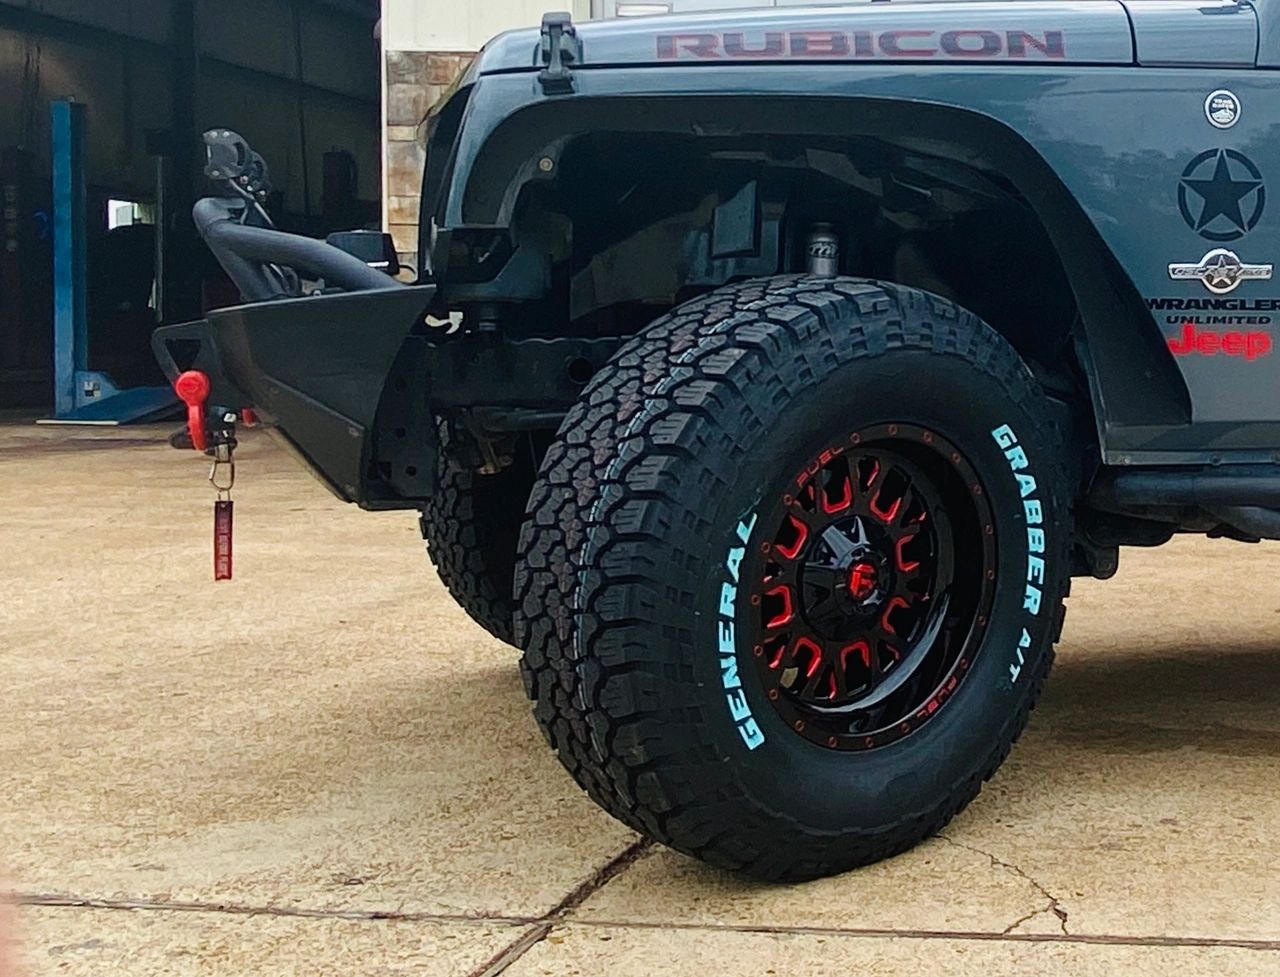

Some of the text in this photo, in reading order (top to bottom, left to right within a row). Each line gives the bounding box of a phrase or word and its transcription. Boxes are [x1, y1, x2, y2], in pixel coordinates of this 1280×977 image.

[656, 29, 1066, 60] RUBICON
[1166, 315, 1271, 325] UNLIMITED
[1167, 323, 1272, 361] Jeep
[992, 424, 1046, 684] GRABBER A/T
[718, 513, 765, 750] GENERAL
